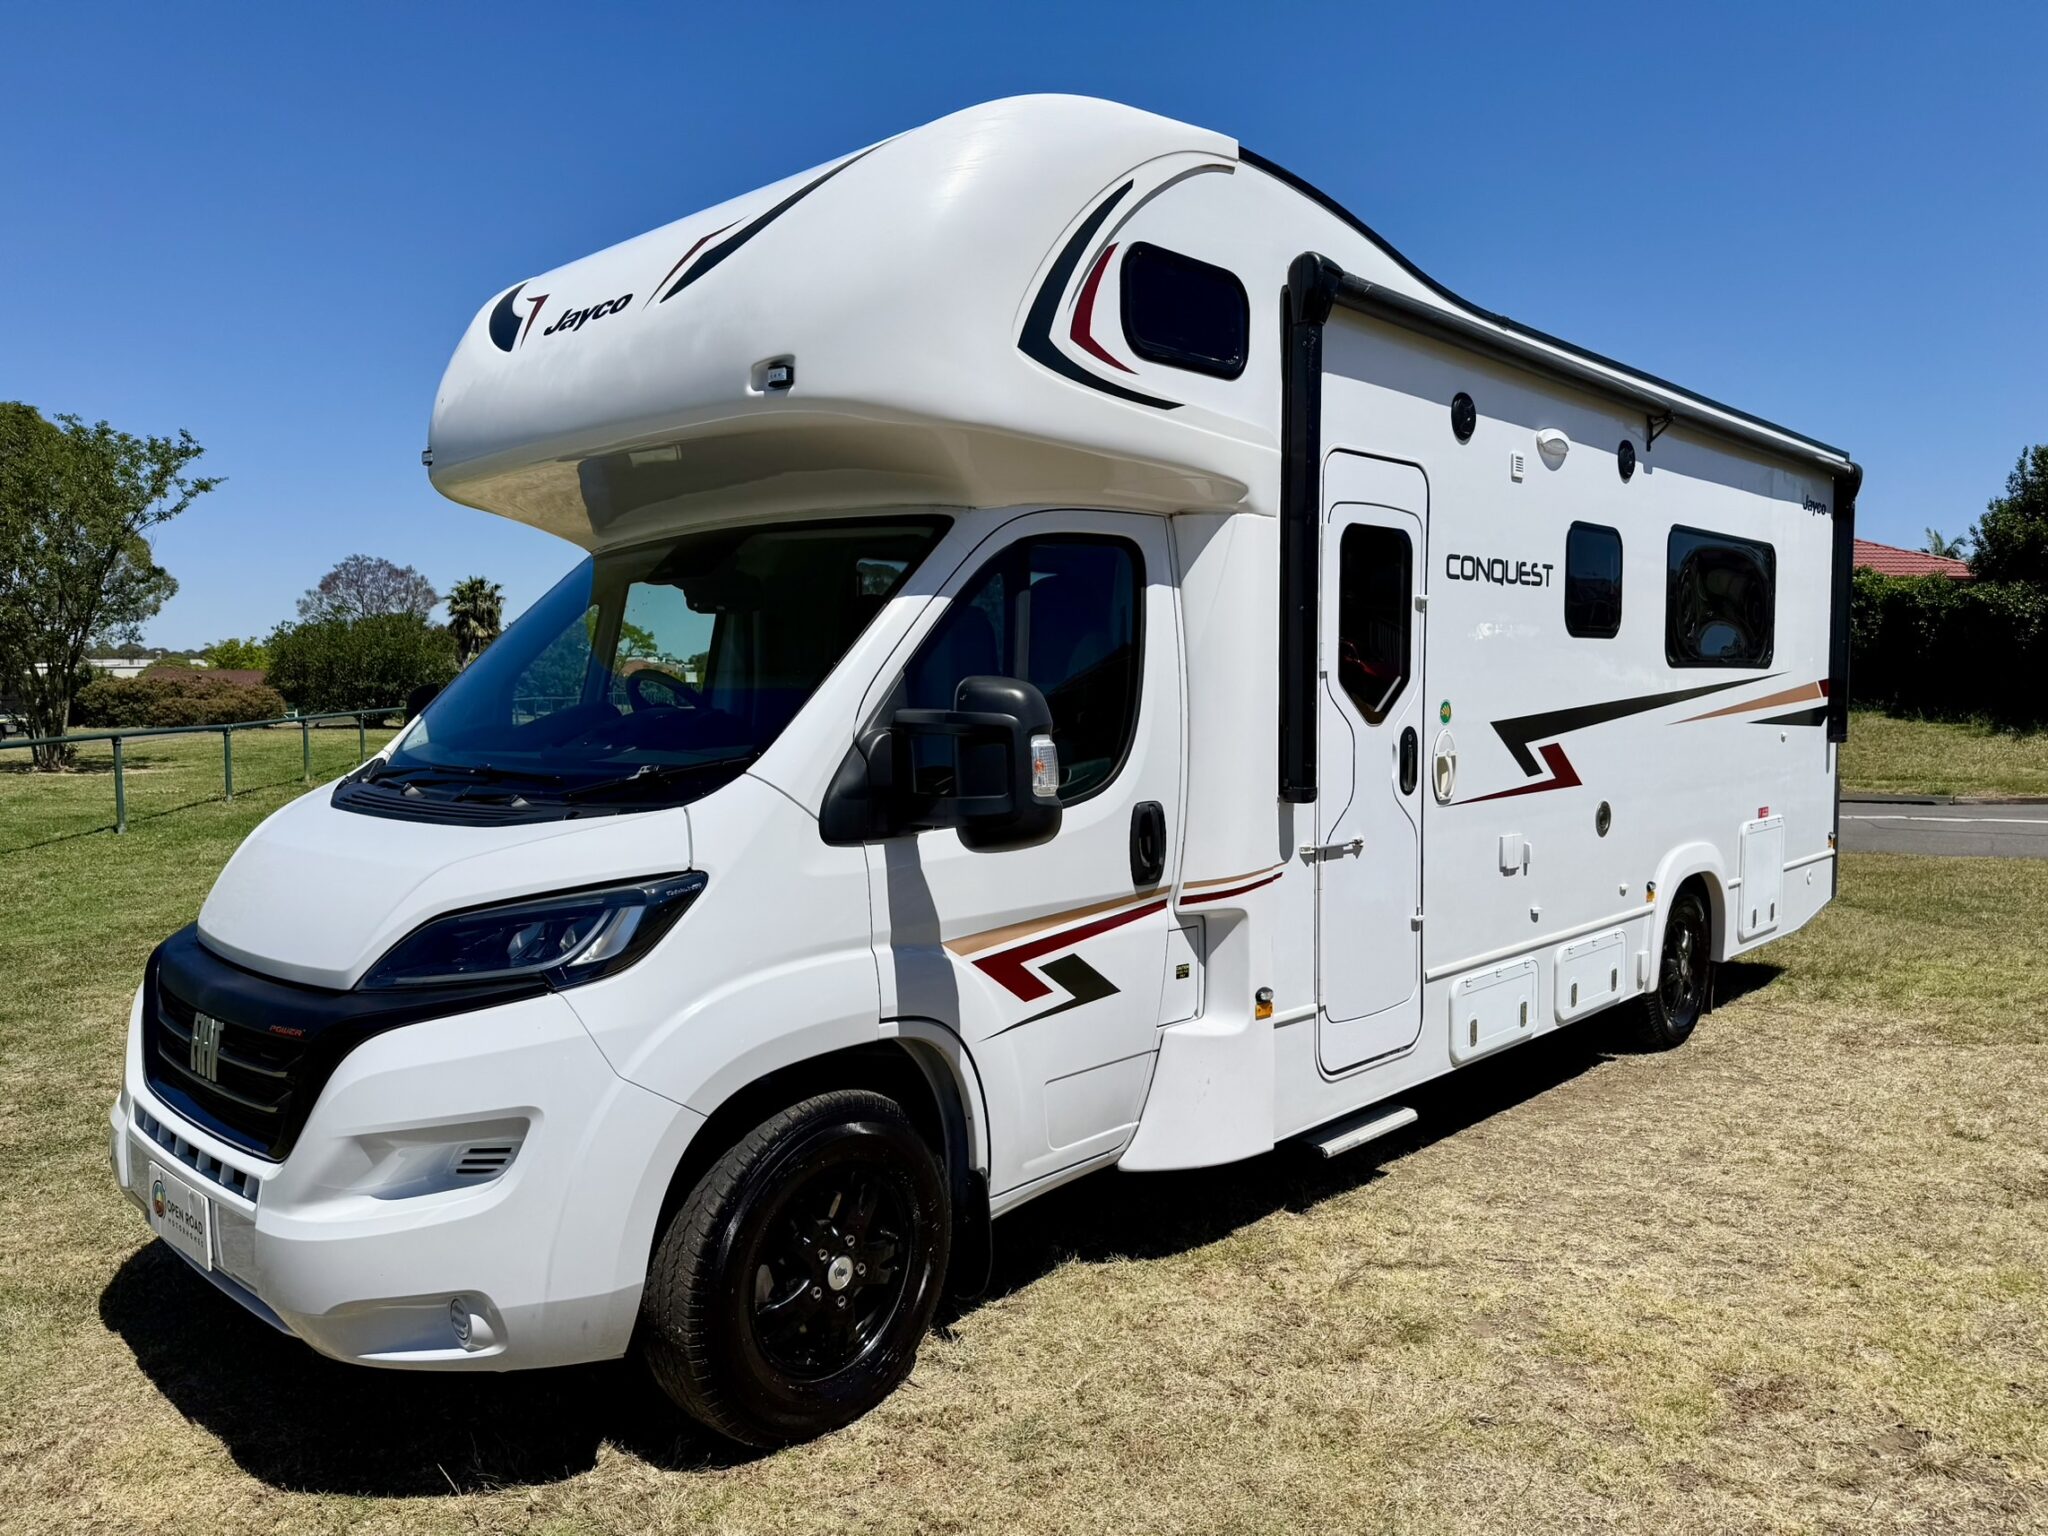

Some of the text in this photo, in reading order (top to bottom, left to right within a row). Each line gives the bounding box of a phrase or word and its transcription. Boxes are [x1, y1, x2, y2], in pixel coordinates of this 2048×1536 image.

[543, 293, 633, 336] Jayco
[1802, 494, 1827, 517] Jayco
[1446, 553, 1554, 588] CONQUEST
[167, 1199, 204, 1235] OPEN ROAD
